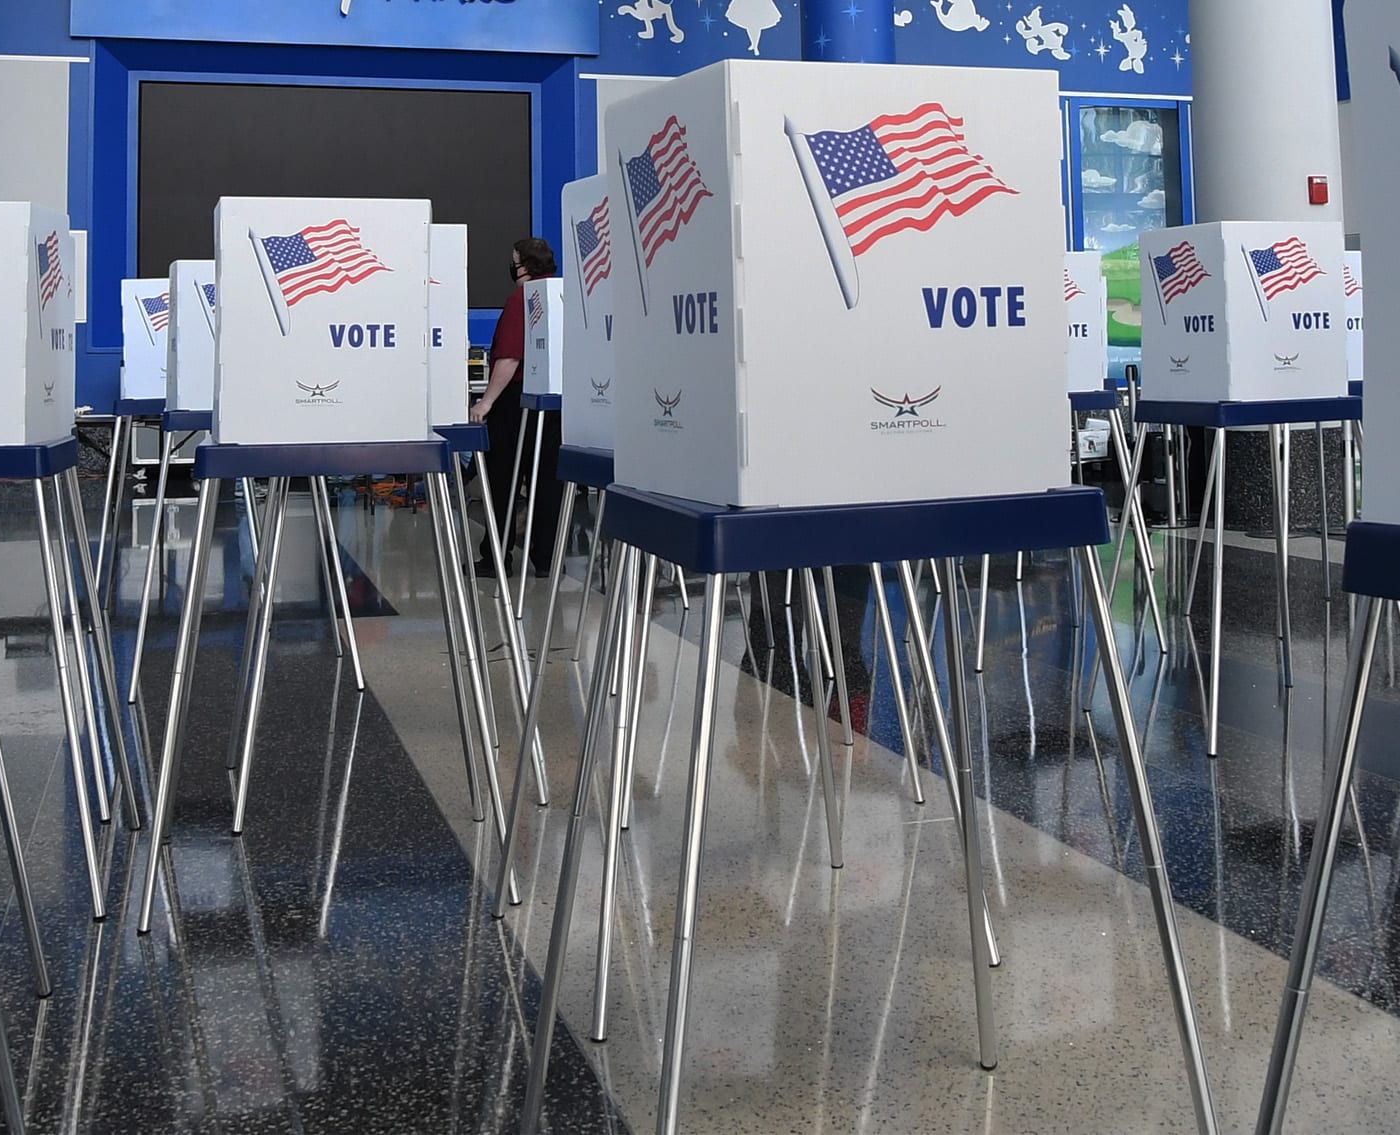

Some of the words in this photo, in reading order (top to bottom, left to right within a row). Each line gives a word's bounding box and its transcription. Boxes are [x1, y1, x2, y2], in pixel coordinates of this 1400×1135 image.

[673, 292, 718, 334] VOTE
[922, 286, 1026, 328] VOTE
[1184, 315, 1215, 332] VOTE
[1292, 312, 1330, 329] VOTE
[1347, 318, 1363, 330] OT
[329, 324, 396, 348] VOTE
[1069, 324, 1088, 337] TE
[870, 419, 943, 430] SMARTPOLL
